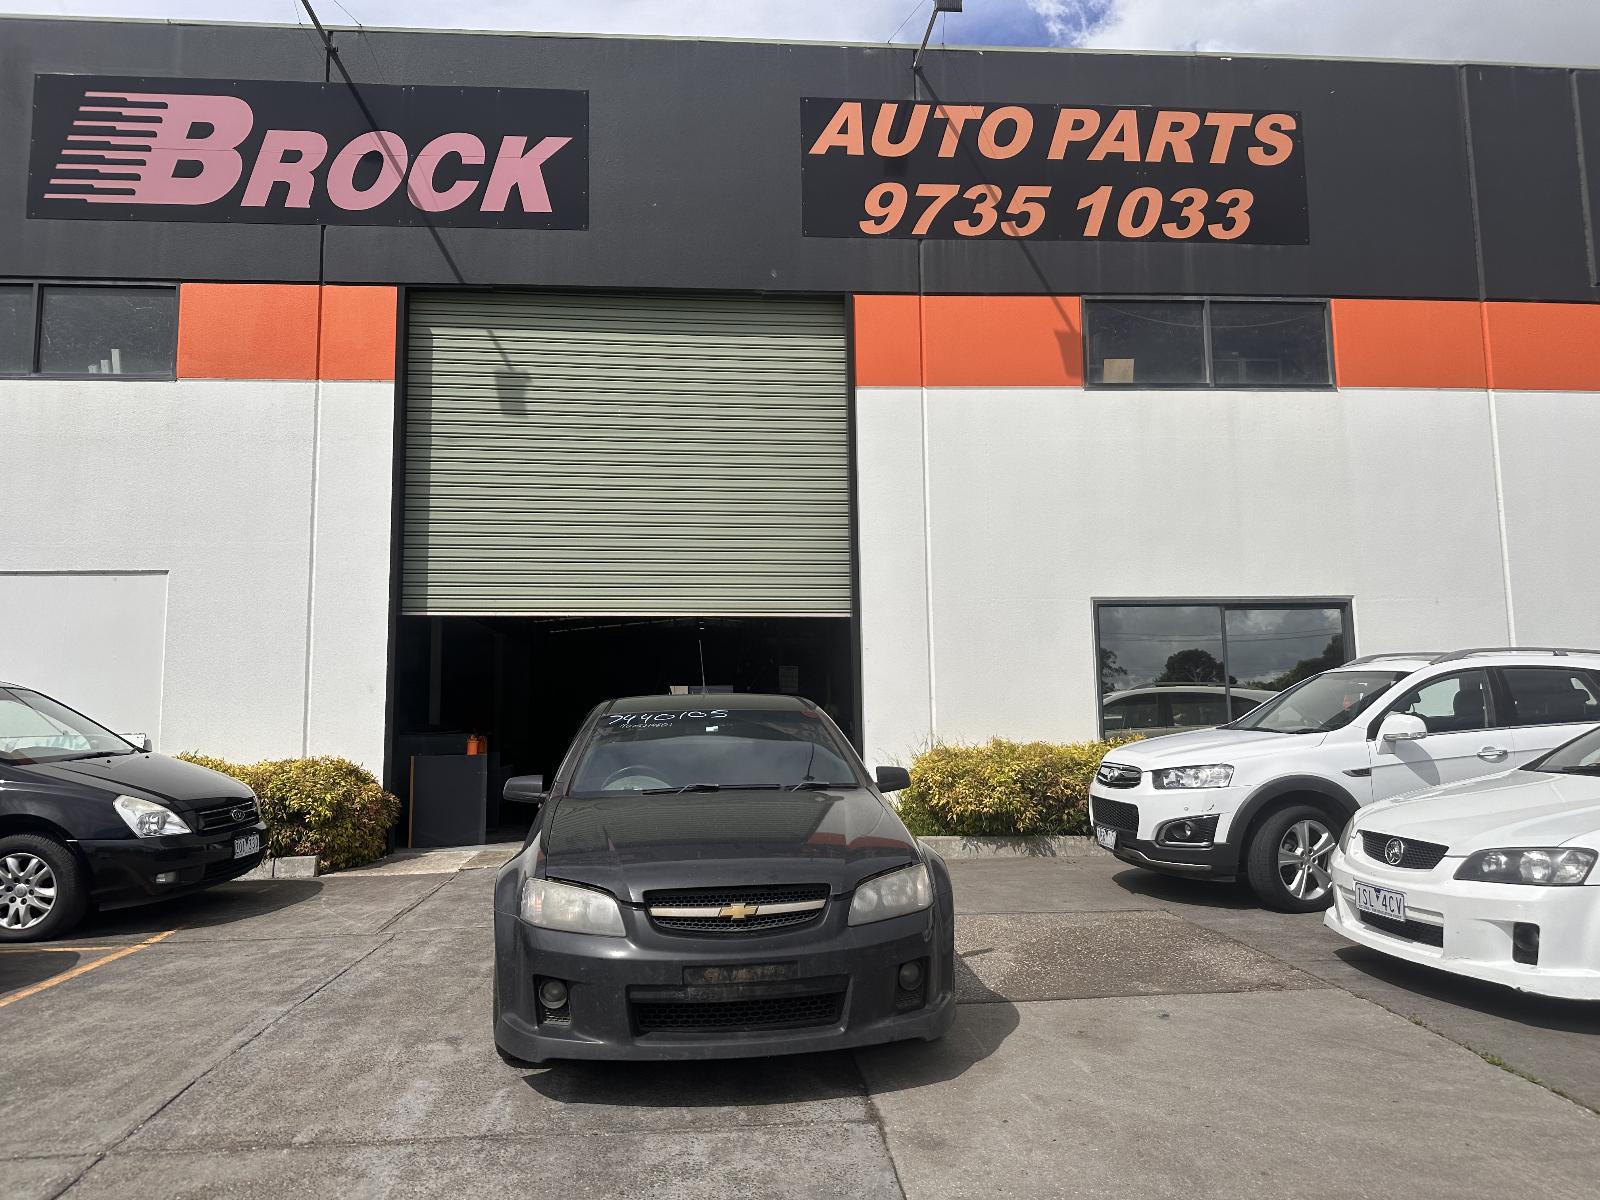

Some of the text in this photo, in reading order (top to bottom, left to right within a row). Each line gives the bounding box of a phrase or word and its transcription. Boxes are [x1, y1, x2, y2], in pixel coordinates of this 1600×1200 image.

[44, 91, 573, 213] BROCK
[808, 102, 1297, 166] AUTO PARTS
[859, 183, 1254, 240] 9735 1033
